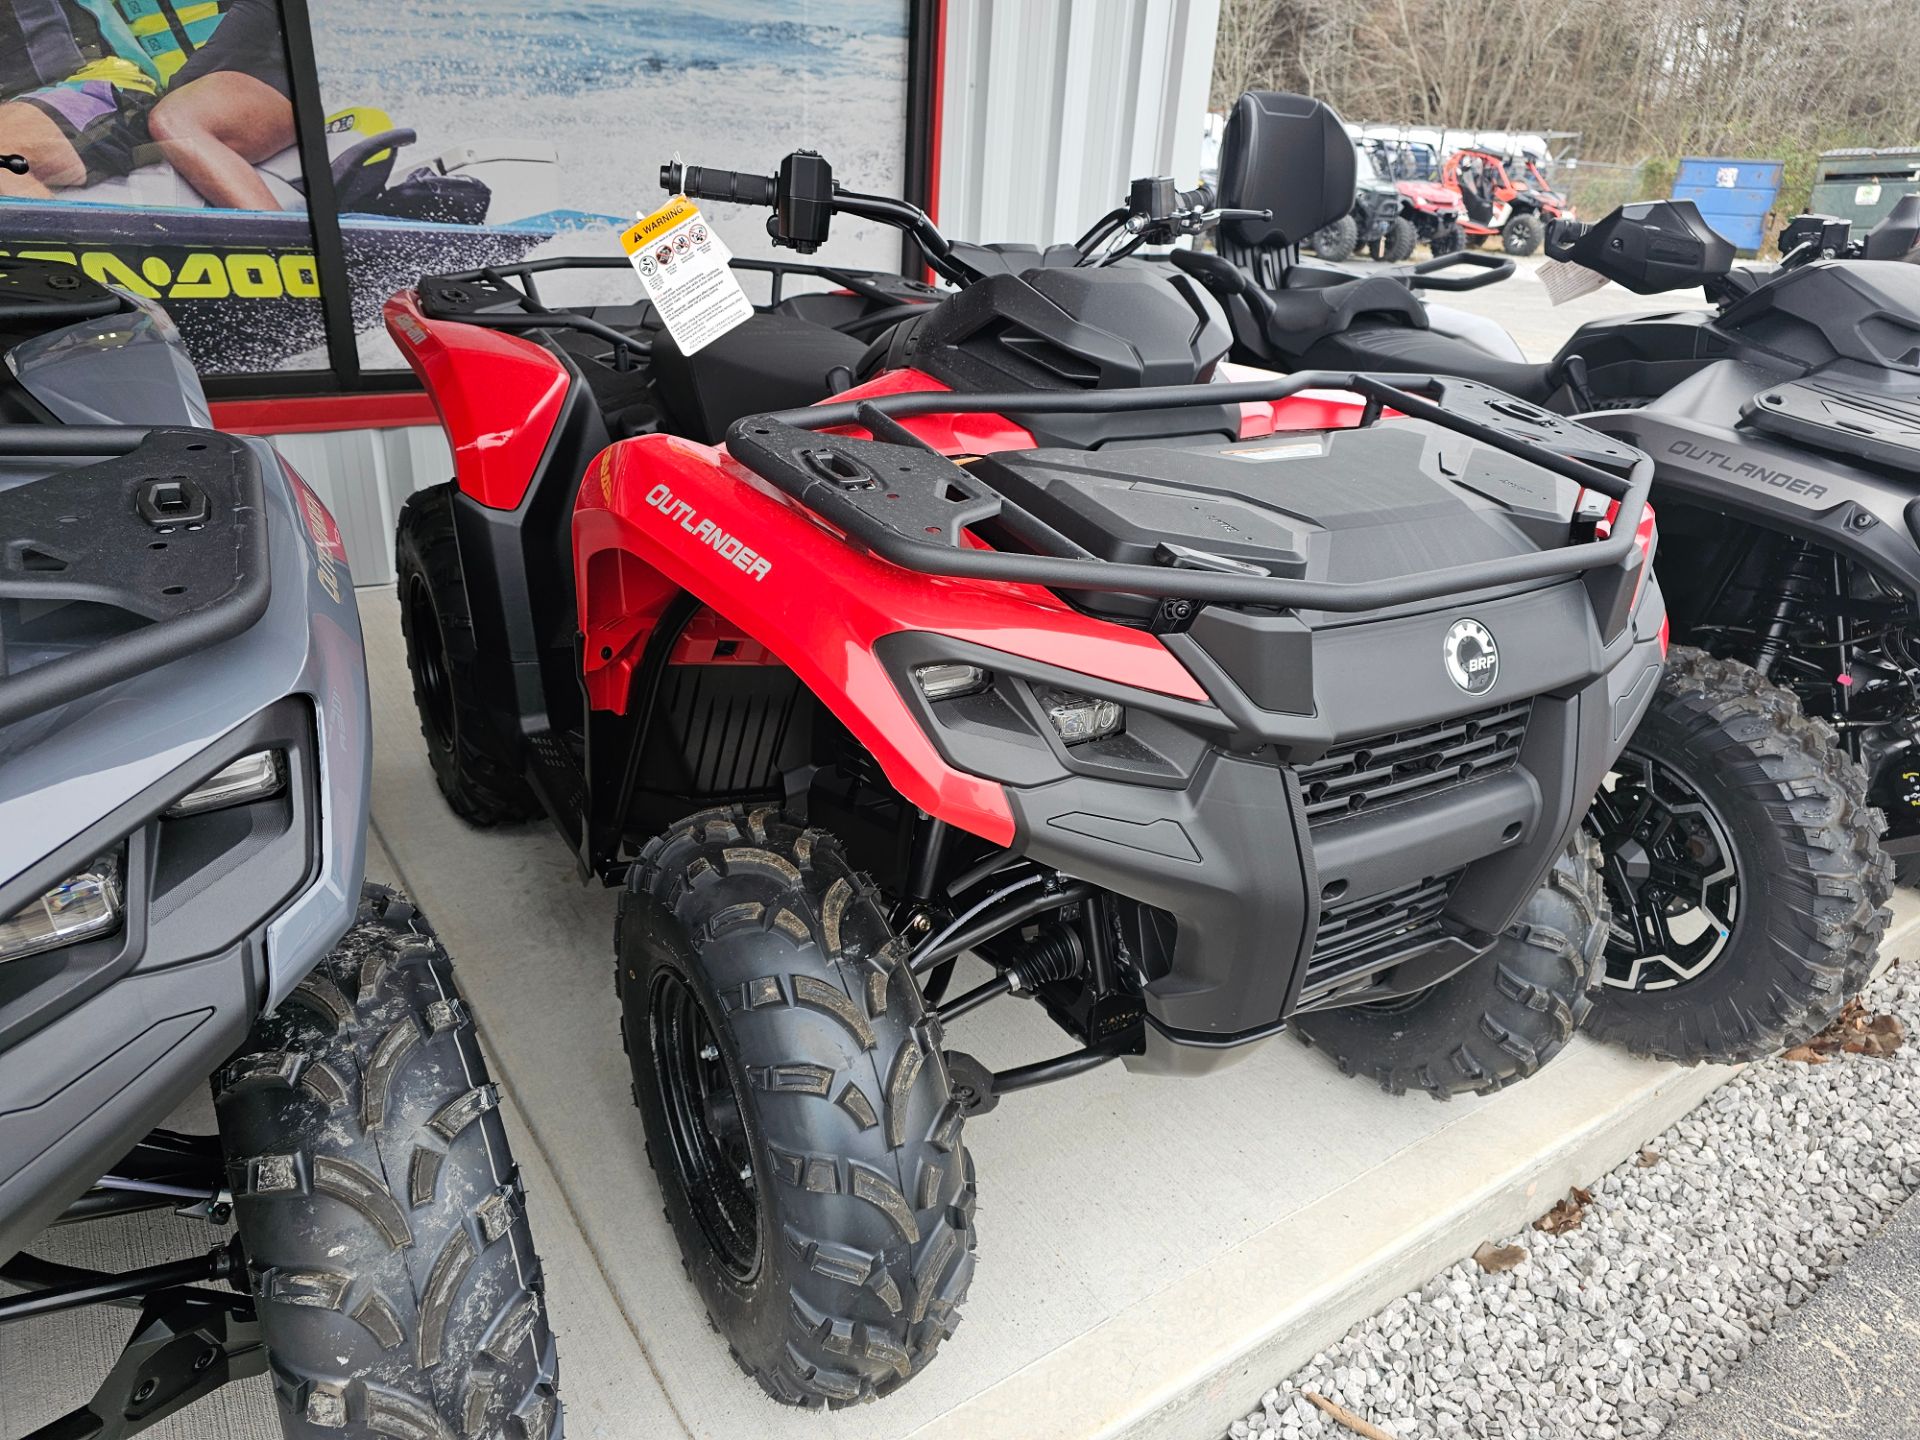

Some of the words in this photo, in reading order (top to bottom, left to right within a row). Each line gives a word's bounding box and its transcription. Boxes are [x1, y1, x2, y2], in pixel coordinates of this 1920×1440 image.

[642, 204, 685, 235] WARNING
[1667, 440, 1828, 500] OUTLANDER
[645, 483, 772, 582] OUTLANDER
[1468, 654, 1496, 673] BRP
